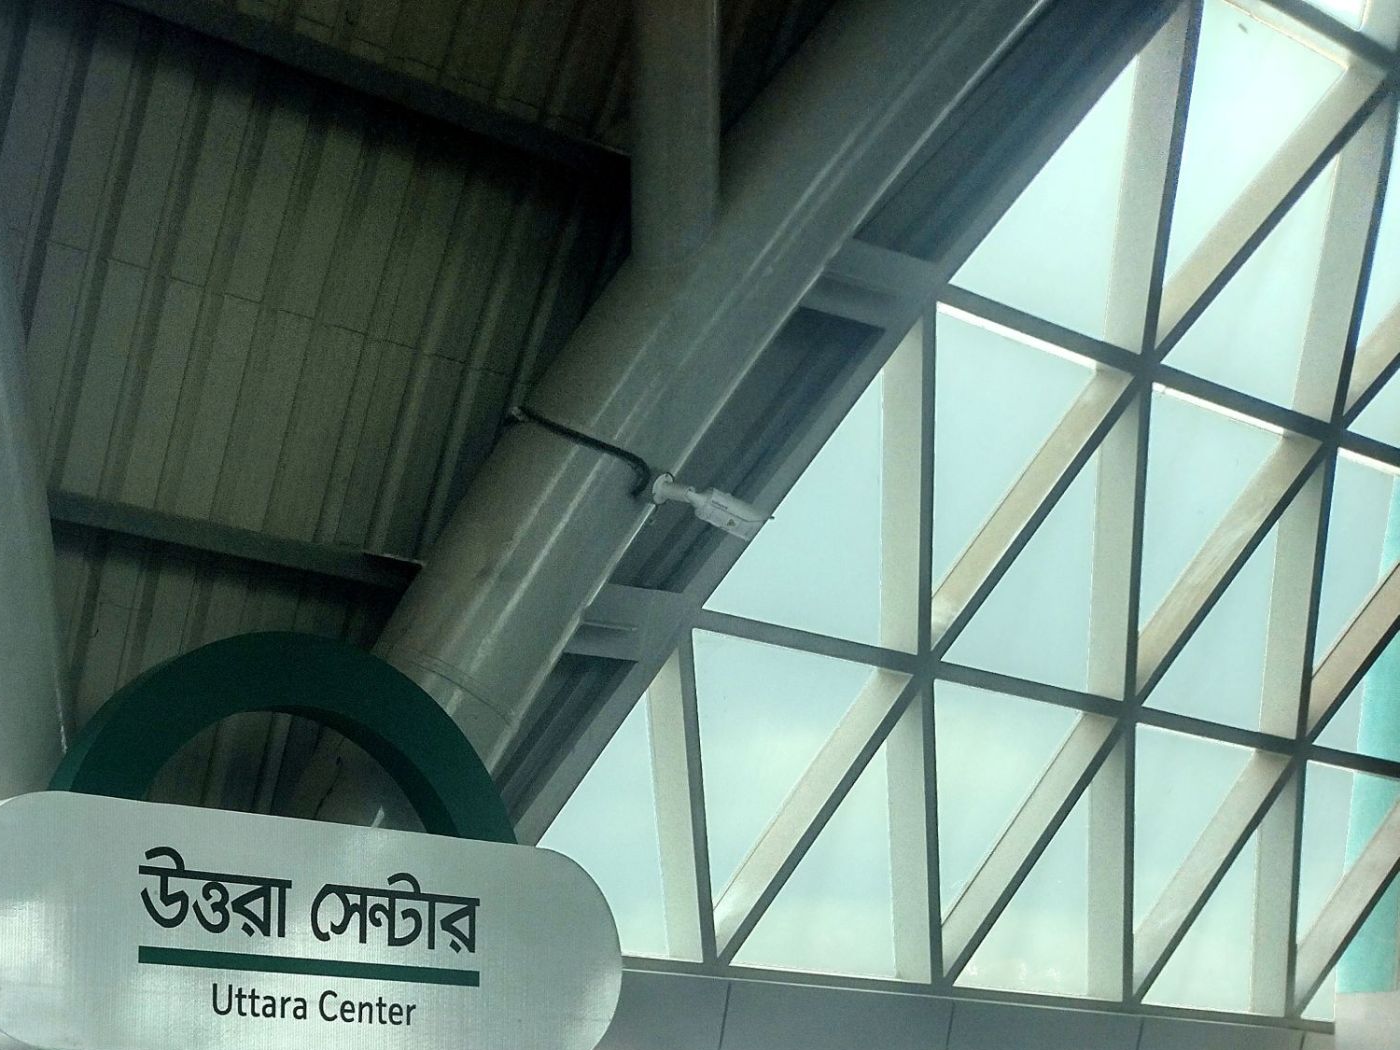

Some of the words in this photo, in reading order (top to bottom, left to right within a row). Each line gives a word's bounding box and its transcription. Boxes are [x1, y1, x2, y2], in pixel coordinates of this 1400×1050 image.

[138, 846, 293, 938] উত্তরা
[310, 872, 481, 954] সেন্টার
[211, 983, 308, 1020] Uttara
[318, 990, 417, 1026] Center
